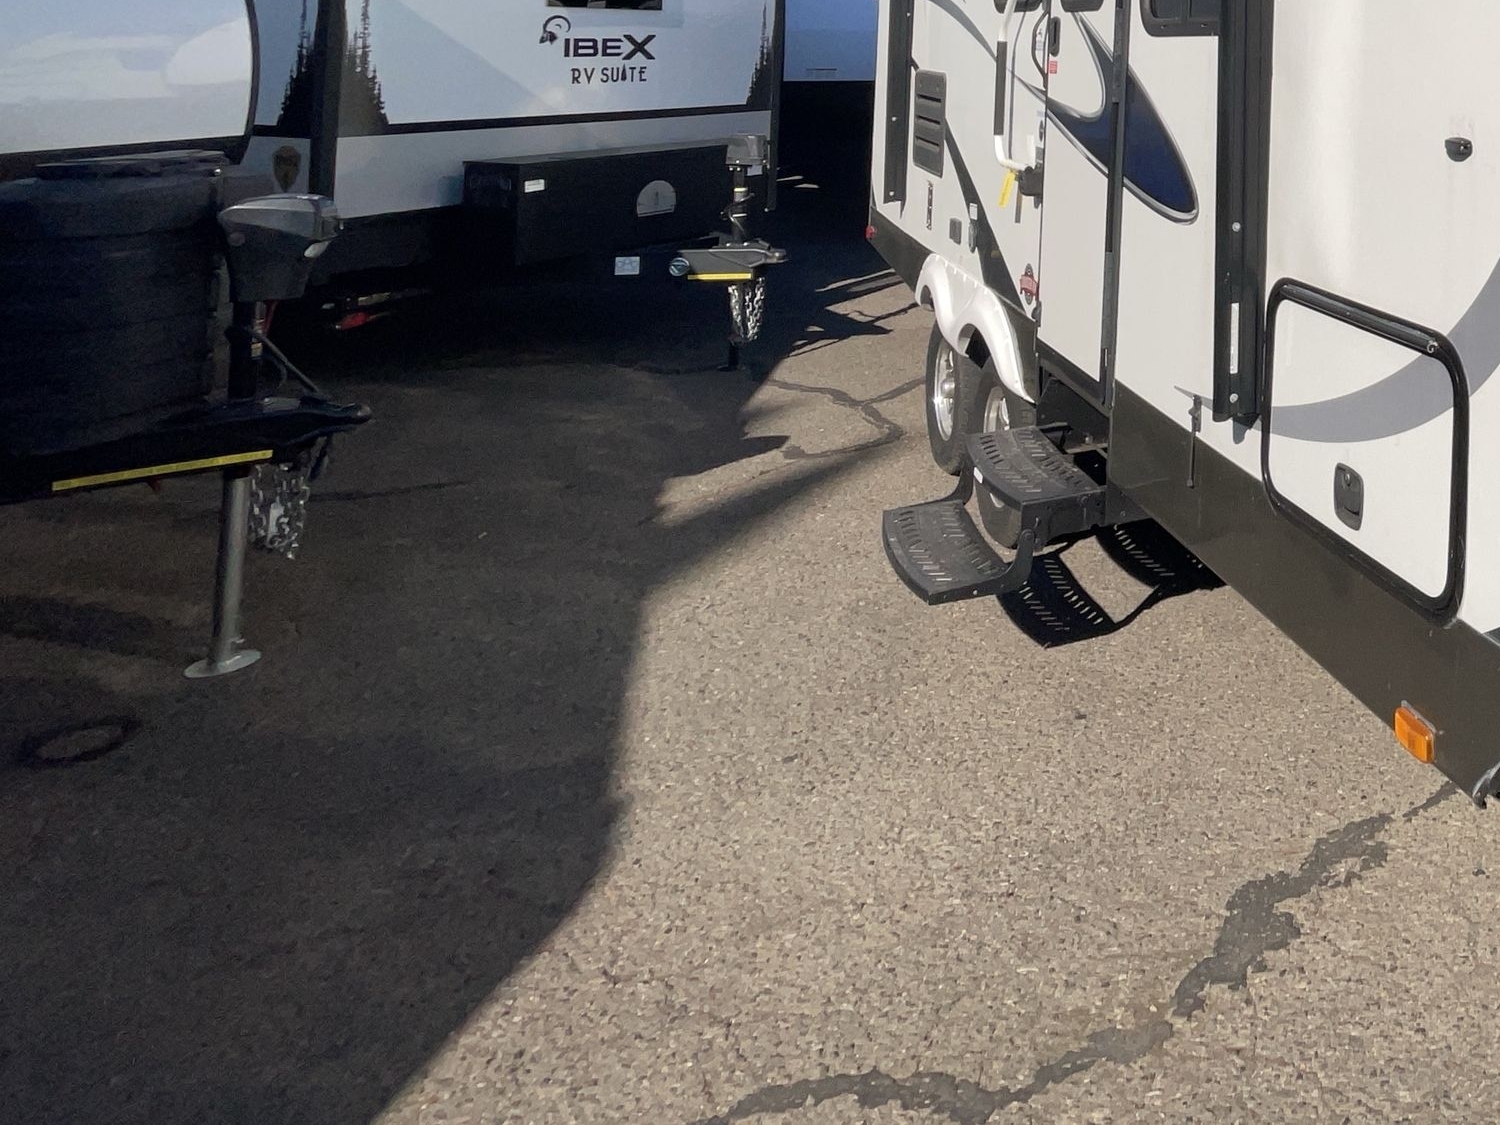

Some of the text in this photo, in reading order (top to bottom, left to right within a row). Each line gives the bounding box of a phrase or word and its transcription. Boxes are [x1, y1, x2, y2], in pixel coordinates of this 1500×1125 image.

[563, 33, 657, 61] IBEX
[570, 63, 648, 85] RV SUITE
